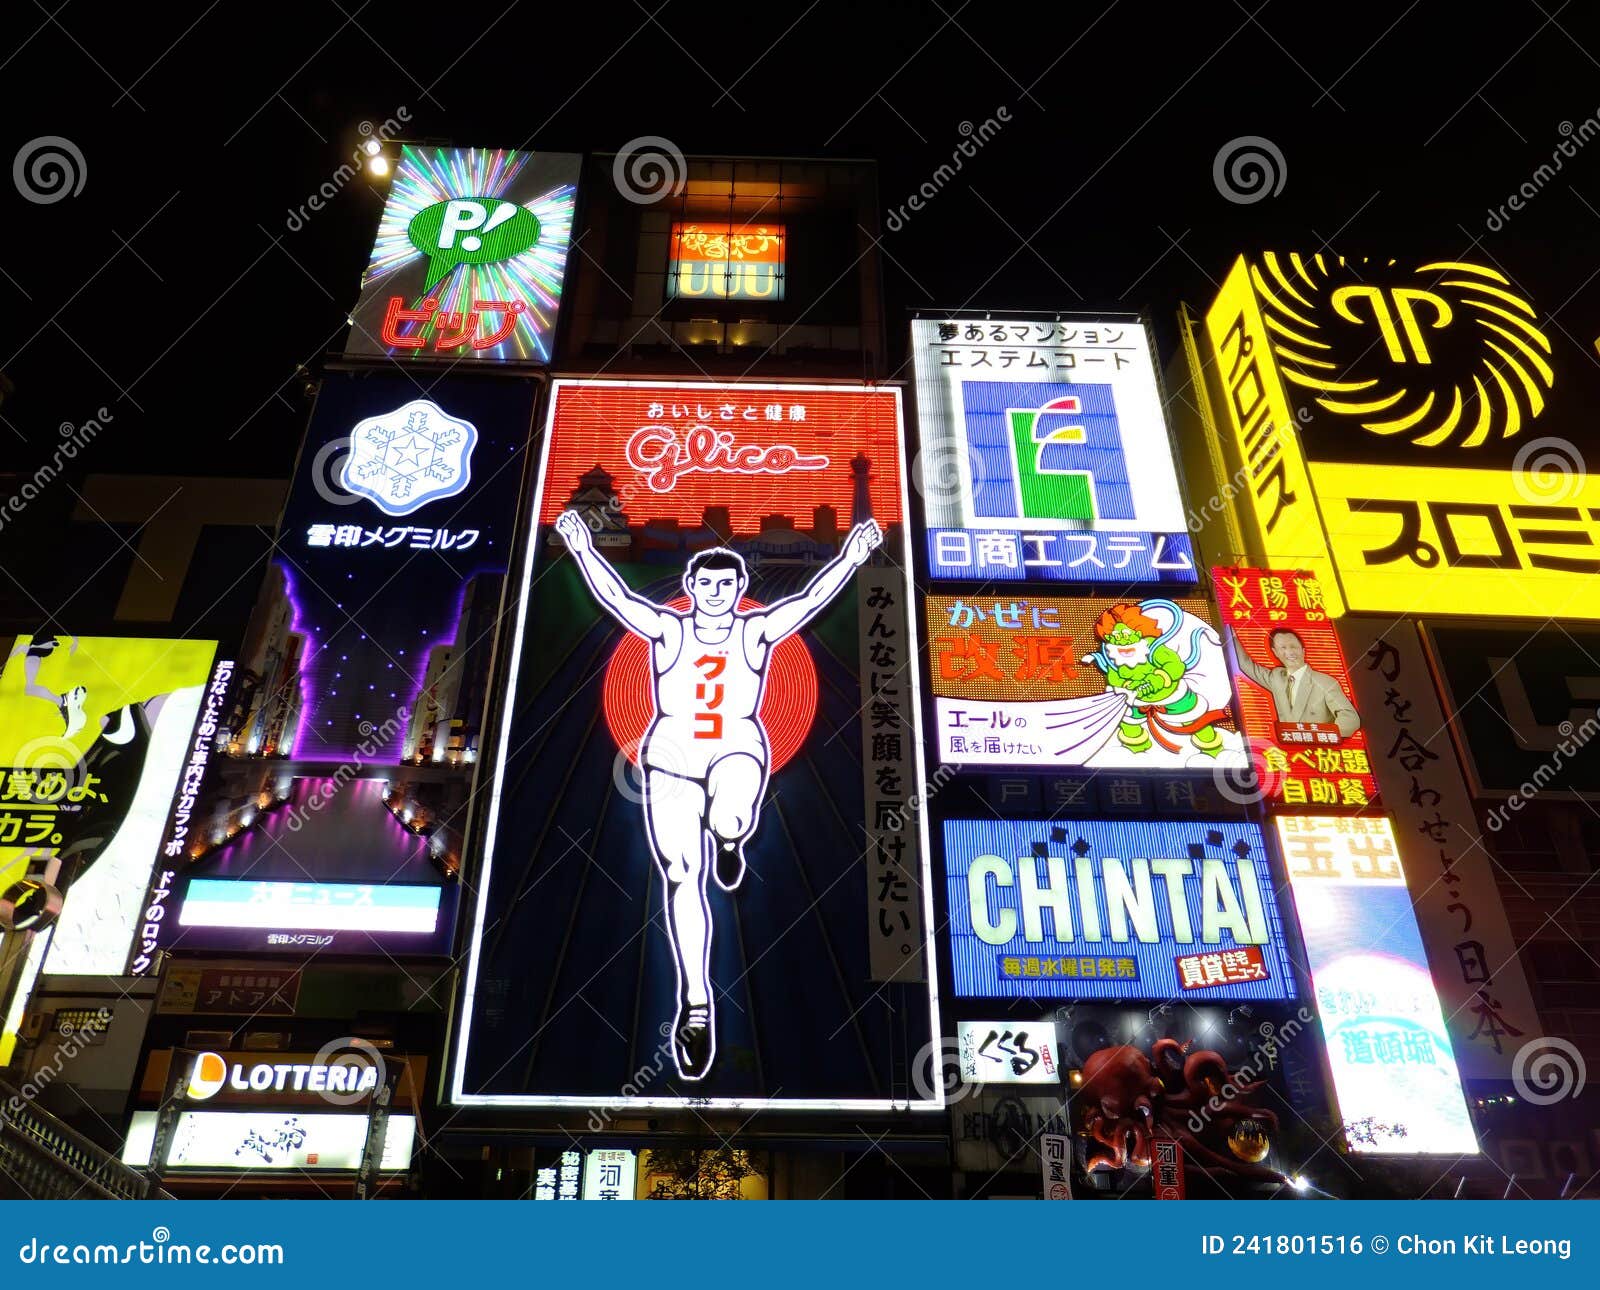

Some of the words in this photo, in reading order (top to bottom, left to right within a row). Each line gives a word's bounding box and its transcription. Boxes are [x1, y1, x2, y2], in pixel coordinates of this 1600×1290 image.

[381, 297, 527, 350] ピップ
[937, 322, 1125, 344] 夢あるマンション
[940, 349, 1131, 371] エステムコート
[648, 403, 807, 421] おいしさと健康
[1219, 309, 1297, 536] プロミス
[307, 524, 480, 550] 雪印メグミルク
[1346, 497, 1600, 574] プロミ
[935, 531, 1193, 570] 日商エステム
[947, 600, 1062, 629] かぜに
[936, 634, 1080, 682] 改源
[693, 650, 729, 739] グリコ
[948, 710, 1027, 729] エールの
[950, 735, 1043, 755] 風を届けたい
[866, 586, 912, 956] みんなに笑顔を届けたい。
[0, 770, 108, 803] 覚めよ、
[967, 854, 1270, 946] CHINTAI
[267, 933, 335, 946] 雪印メグミルク
[1002, 957, 1137, 978] 毎週水曜日発売
[231, 1064, 379, 1092] LOTTERIA
